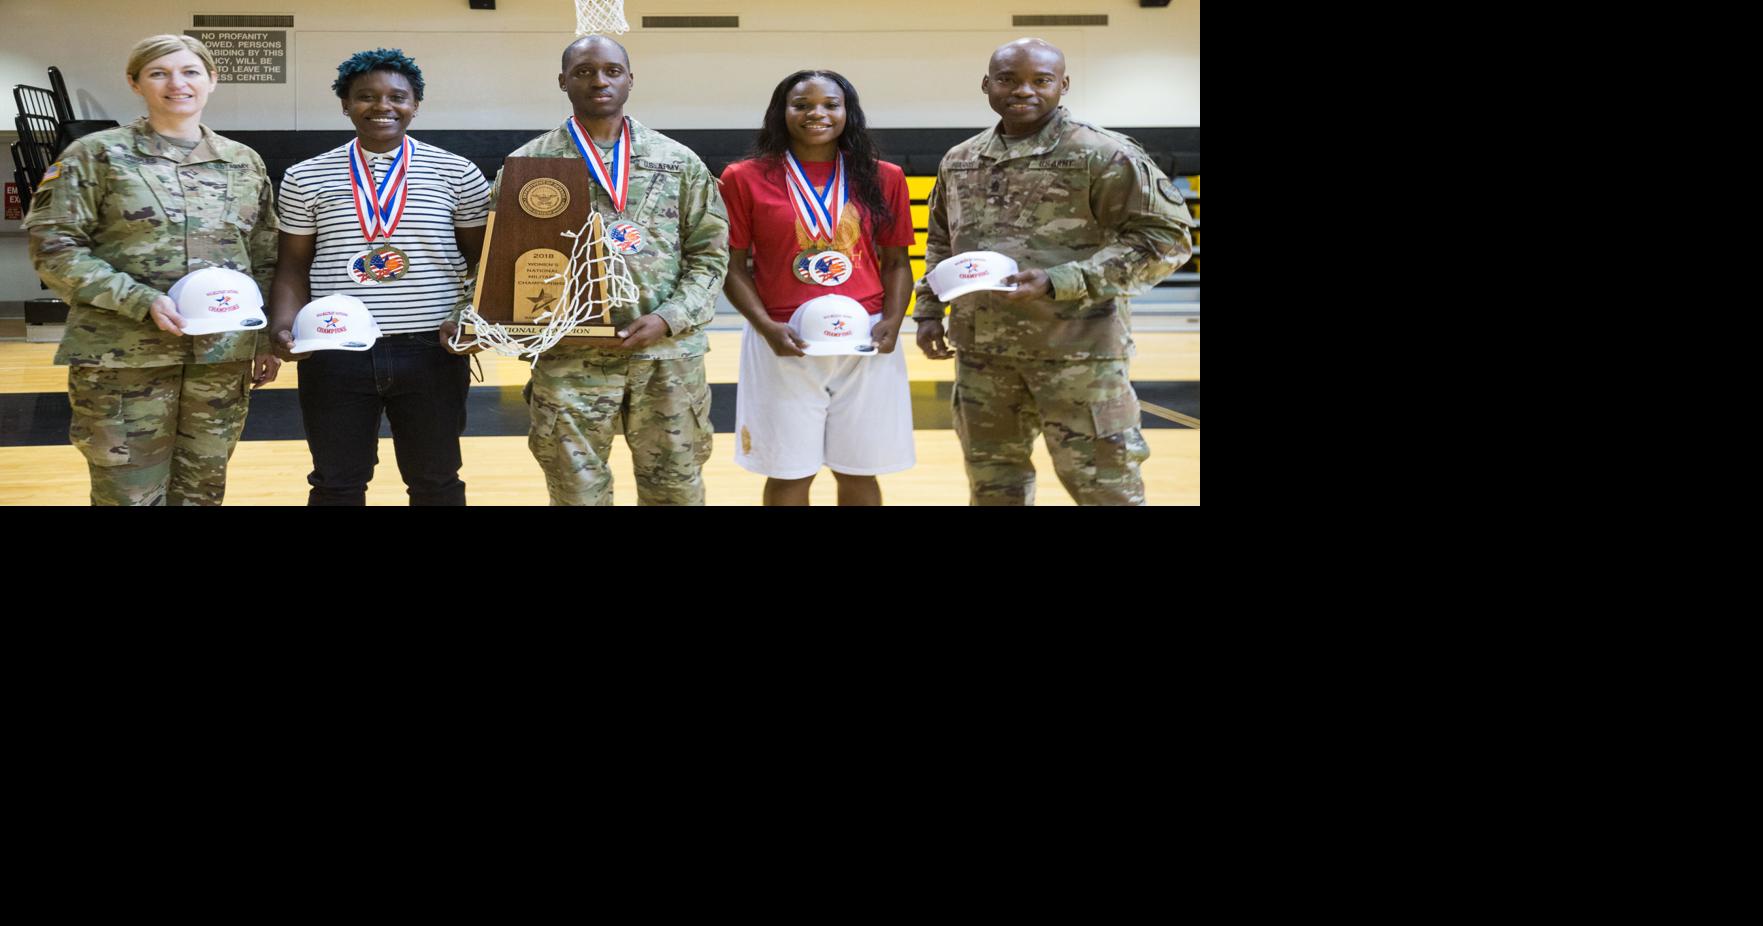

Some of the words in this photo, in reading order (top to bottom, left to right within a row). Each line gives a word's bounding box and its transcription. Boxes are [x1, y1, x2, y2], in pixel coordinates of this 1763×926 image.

[214, 57, 233, 65] ICY,
[236, 57, 257, 65] WILL
[260, 57, 273, 65] BE
[218, 65, 229, 73] TO
[232, 65, 260, 73] LEAVE
[264, 65, 281, 73] THE
